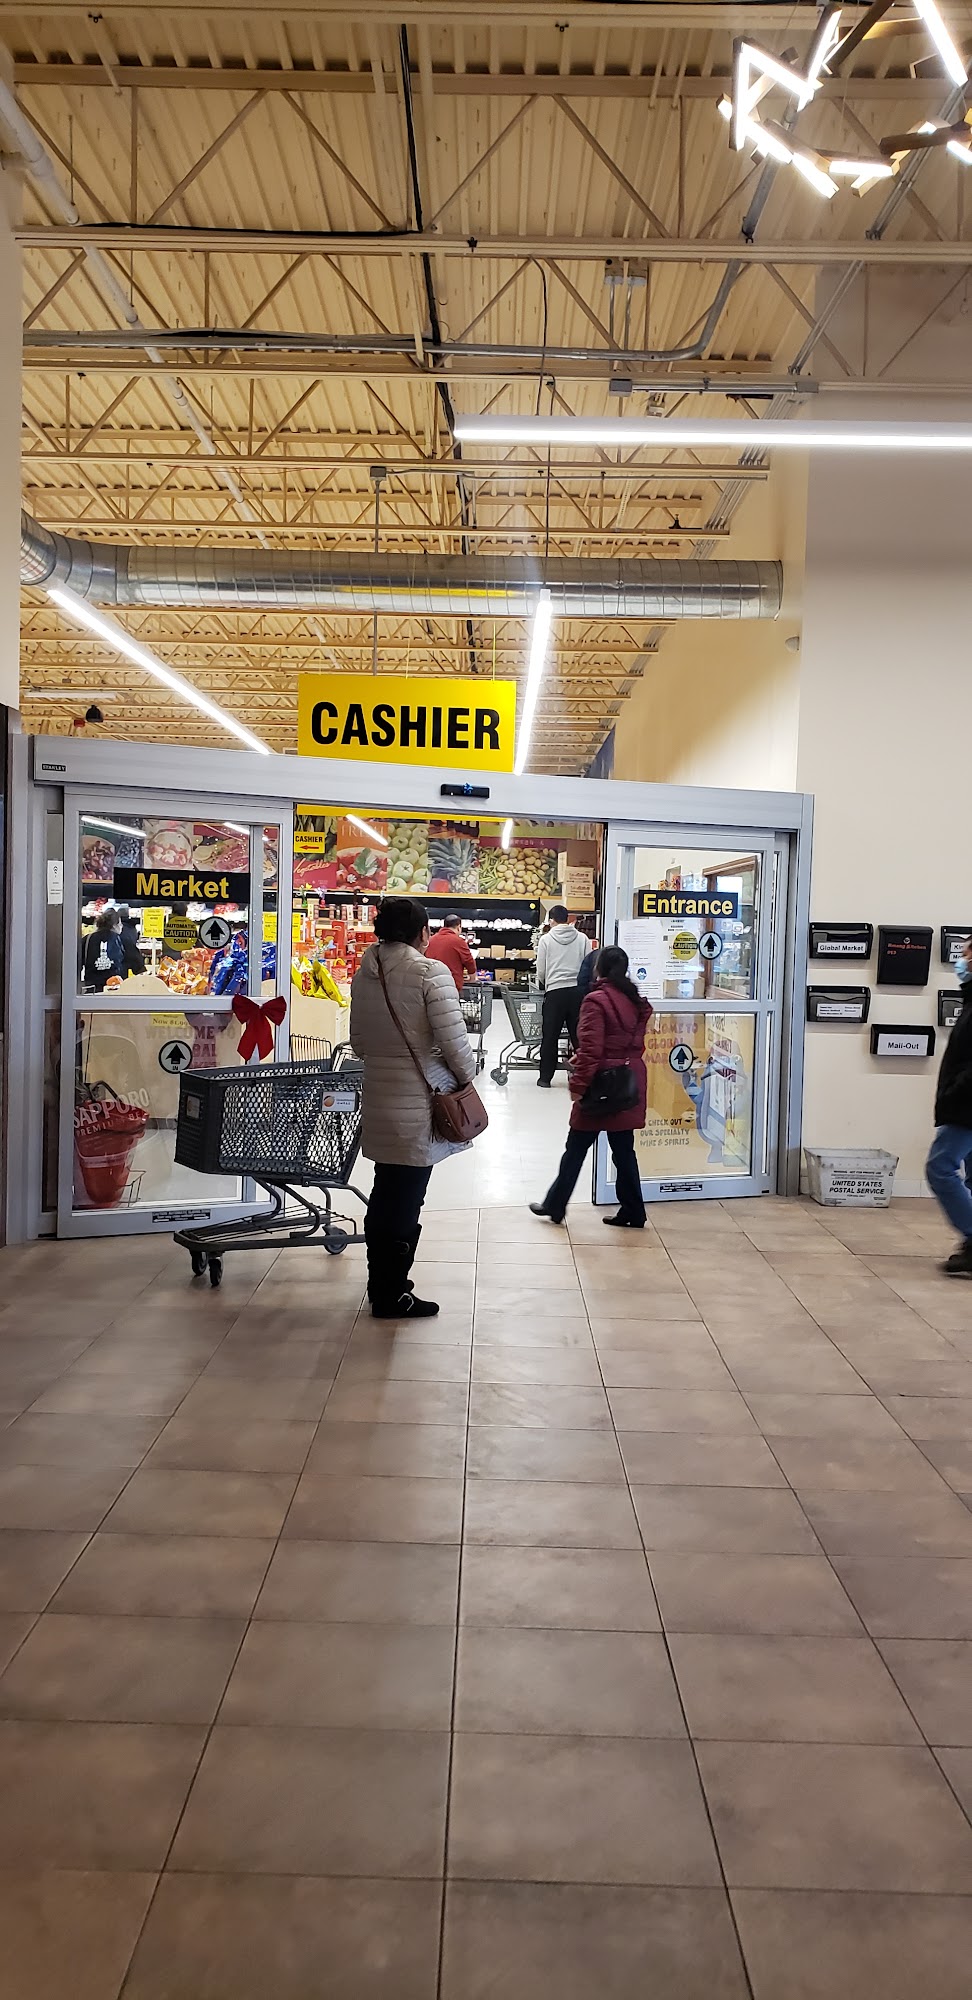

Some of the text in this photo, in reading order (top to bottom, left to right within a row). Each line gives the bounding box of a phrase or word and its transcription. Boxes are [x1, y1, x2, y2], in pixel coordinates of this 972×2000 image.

[311, 701, 500, 750] CASHIER
[136, 873, 229, 898] Market
[643, 894, 734, 915] Entrance
[887, 1041, 919, 1050] Mail-Out
[74, 1088, 150, 1129] SAPPORO
[648, 1117, 683, 1127] CHECK OUT
[640, 1129, 690, 1137] OUR SPECIALTY
[640, 1139, 656, 1147] WINE
[664, 1138, 690, 1147] SPIRITS
